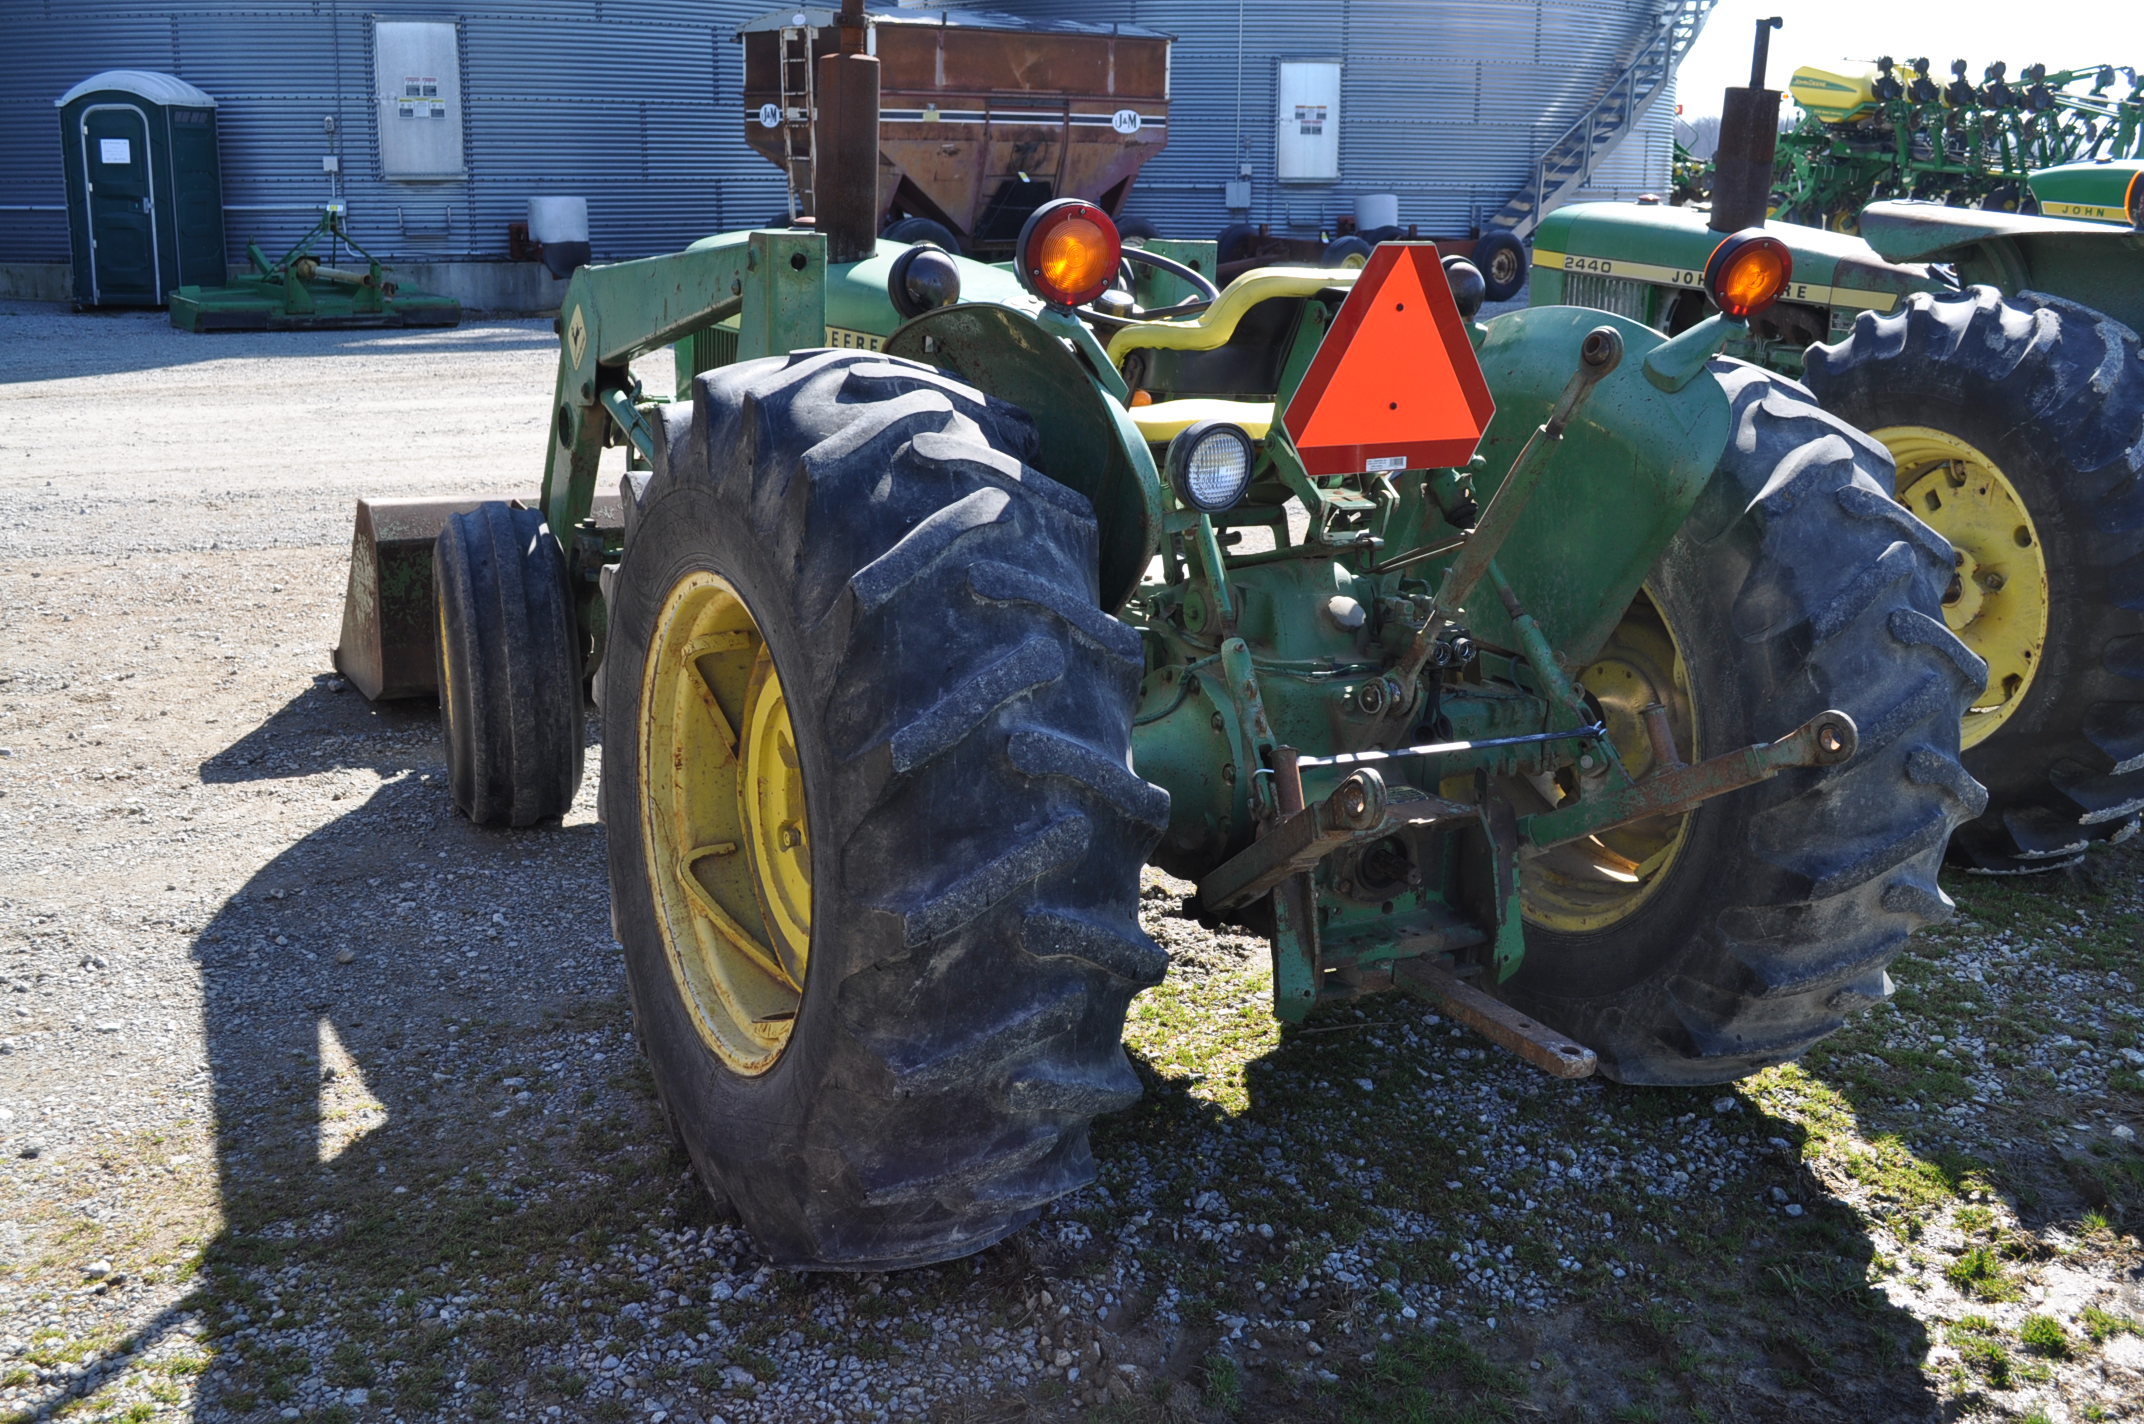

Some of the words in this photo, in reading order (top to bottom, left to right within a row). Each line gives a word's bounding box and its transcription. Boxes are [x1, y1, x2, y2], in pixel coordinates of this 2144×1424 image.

[1114, 113, 1137, 129] J&M
[2062, 205, 2105, 217] JOHN
[1564, 256, 1612, 274] 2440
[825, 331, 878, 352] EERE
